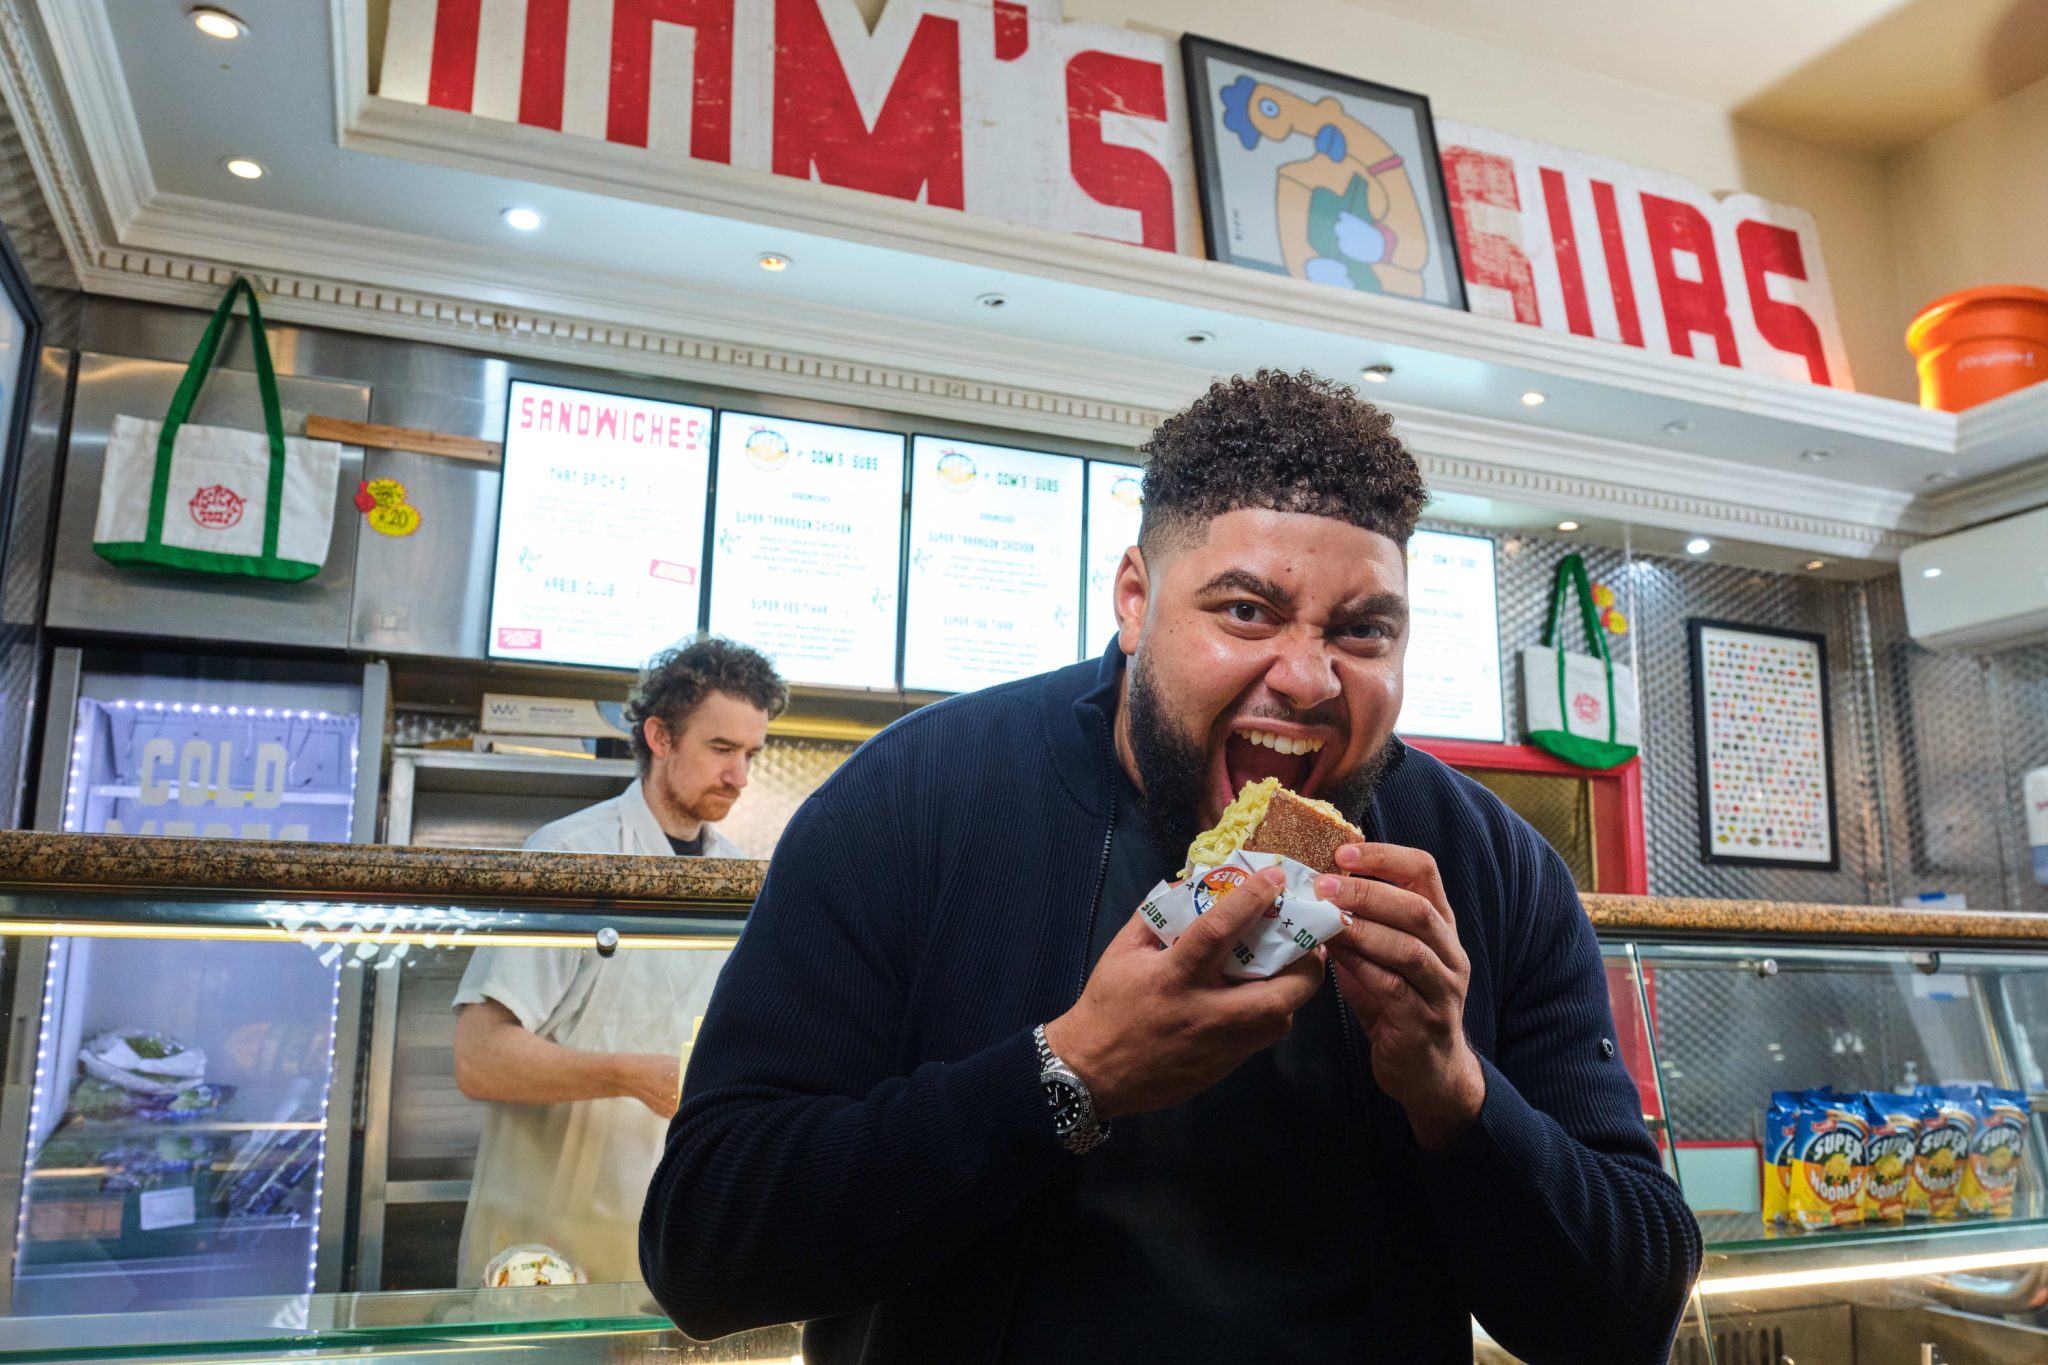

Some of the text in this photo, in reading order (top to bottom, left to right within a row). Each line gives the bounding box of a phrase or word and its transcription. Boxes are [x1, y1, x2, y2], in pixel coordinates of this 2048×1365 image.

[520, 396, 699, 450] SANDWICHES
[811, 449, 878, 471] DOM'S SUBS
[996, 471, 1060, 493] DOM'S SUBS
[140, 738, 287, 810] COLD
[1141, 901, 1168, 929] SUBS
[1813, 1132, 1862, 1162] SUPER
[1870, 1136, 1915, 1165] SUPER
[1920, 1129, 1968, 1157] SUPER
[1980, 1127, 2022, 1153] SUPER
[1811, 1169, 1862, 1202] NOODLES
